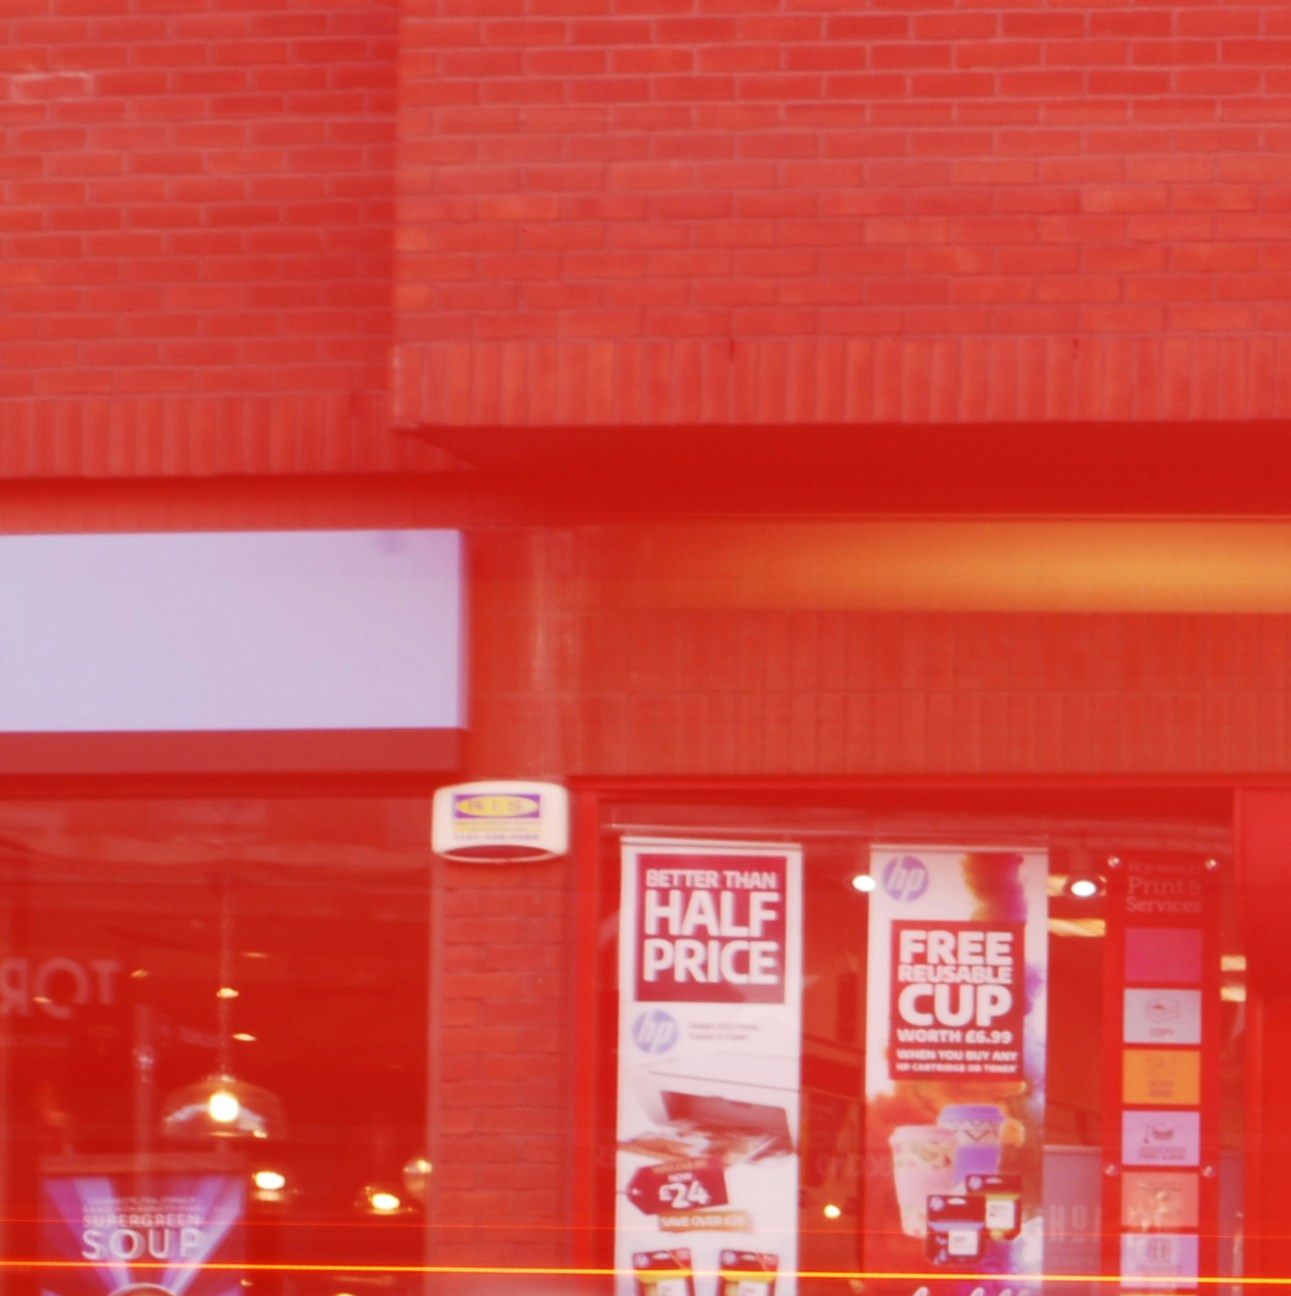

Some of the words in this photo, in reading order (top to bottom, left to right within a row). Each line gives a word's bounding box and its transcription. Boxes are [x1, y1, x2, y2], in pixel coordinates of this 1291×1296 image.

[645, 868, 719, 888] BETTER
[722, 869, 778, 889] THAN
[883, 856, 929, 902] hp
[1128, 876, 1185, 895] Print
[644, 889, 781, 937] HALF
[1126, 896, 1201, 912] Services
[899, 930, 1013, 965] FREE
[643, 938, 780, 985] PRICE
[897, 964, 1013, 984] REUSABLE
[897, 983, 1013, 1027] CUP
[896, 1029, 963, 1043] WORTH
[965, 1029, 1012, 1044] £6.99
[896, 1049, 937, 1060] WHEN
[938, 1049, 963, 1060] YOU
[965, 1049, 990, 1061] BUY
[992, 1050, 1018, 1061] ANY
[658, 1180, 711, 1209] £24
[83, 1213, 201, 1227] SUPERGREEN
[82, 1227, 206, 1260] SOUP
